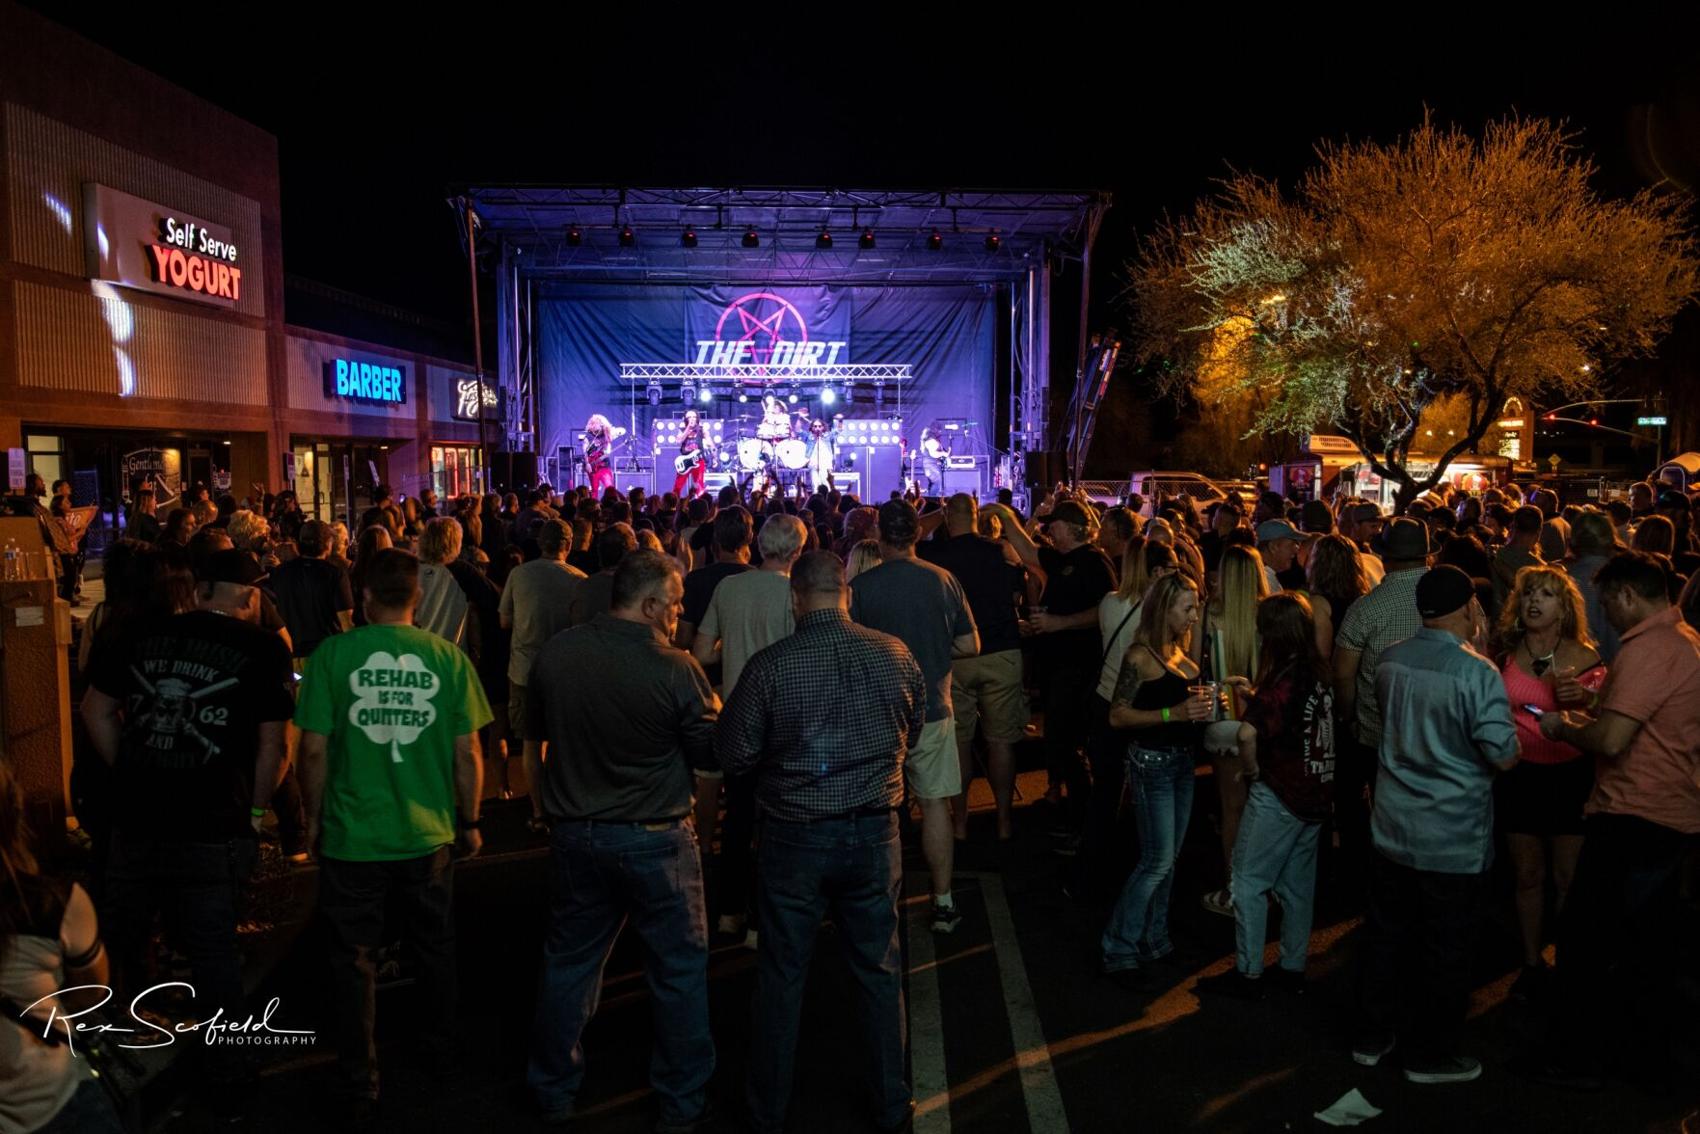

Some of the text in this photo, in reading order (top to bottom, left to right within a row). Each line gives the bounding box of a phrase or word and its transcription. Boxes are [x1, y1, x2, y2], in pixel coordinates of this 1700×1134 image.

[166, 217, 237, 262] Self Serve
[152, 244, 241, 300] YOGURT
[694, 340, 847, 365] THE DIRT
[336, 358, 402, 402] BARBER
[143, 658, 220, 683] WE DRINK
[358, 668, 433, 690] REHAB
[378, 690, 414, 706] IS FOR
[199, 704, 230, 727] 62
[357, 707, 430, 728] QUITTERS
